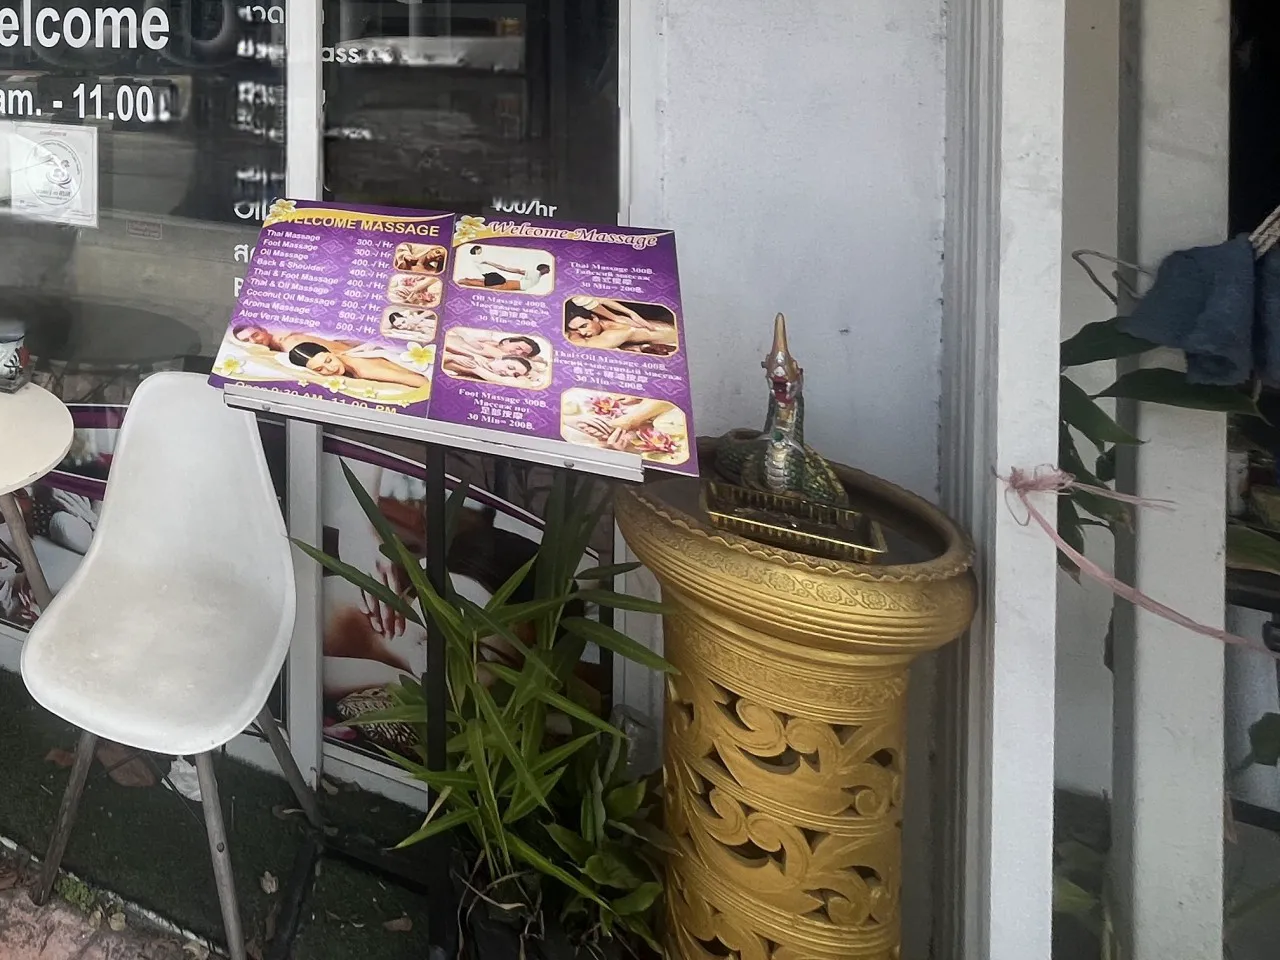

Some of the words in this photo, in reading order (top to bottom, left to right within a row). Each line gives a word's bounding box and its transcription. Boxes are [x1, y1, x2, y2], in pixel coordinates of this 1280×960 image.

[72, 82, 155, 123] 11.00
[282, 215, 356, 230] WELCOME
[360, 219, 440, 237] MASSAGE
[285, 231, 321, 242] Massage
[488, 221, 567, 239] Welcome
[572, 227, 658, 250] Massage
[282, 241, 318, 251] Massage
[260, 248, 271, 256] Oil
[273, 250, 308, 260] Massage
[281, 271, 300, 279] Foot
[300, 273, 339, 285] Massage
[291, 283, 329, 295] Massage
[247, 288, 281, 299] Coconut
[297, 294, 336, 306] Massage
[271, 302, 310, 314] Massage
[281, 315, 320, 327] Massage
[459, 388, 479, 397] Foot
[481, 392, 520, 405] Massage
